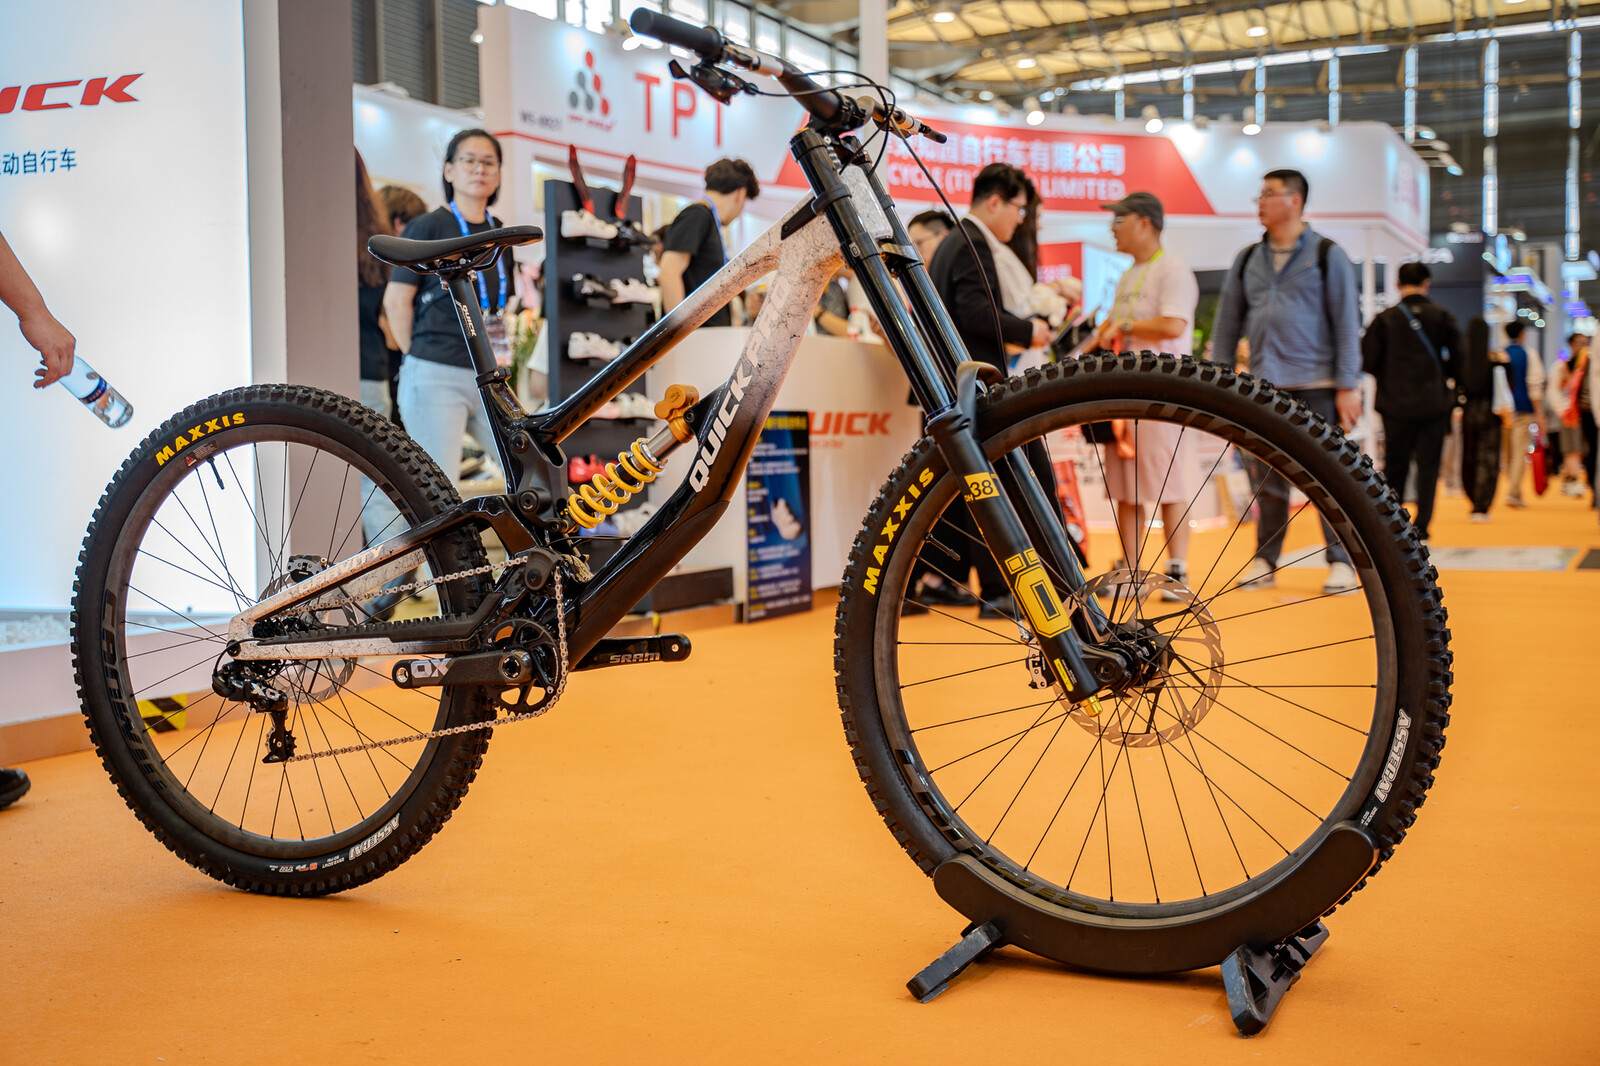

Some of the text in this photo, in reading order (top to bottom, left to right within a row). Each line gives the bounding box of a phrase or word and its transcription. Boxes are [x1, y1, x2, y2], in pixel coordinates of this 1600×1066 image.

[0, 147, 77, 176] 动自行车
[1039, 175, 1126, 201] LIMITED
[462, 304, 477, 337] QUICK
[689, 363, 752, 493] QUICK
[746, 275, 791, 369] PRO
[155, 412, 246, 466] MAXXIS
[808, 411, 892, 435] UICK
[970, 480, 993, 498] 38
[863, 467, 934, 596] MAXXIS
[609, 650, 661, 664] SRAM
[1374, 708, 1411, 803] ASSEGAI
[348, 812, 400, 861] ASSEGAI
